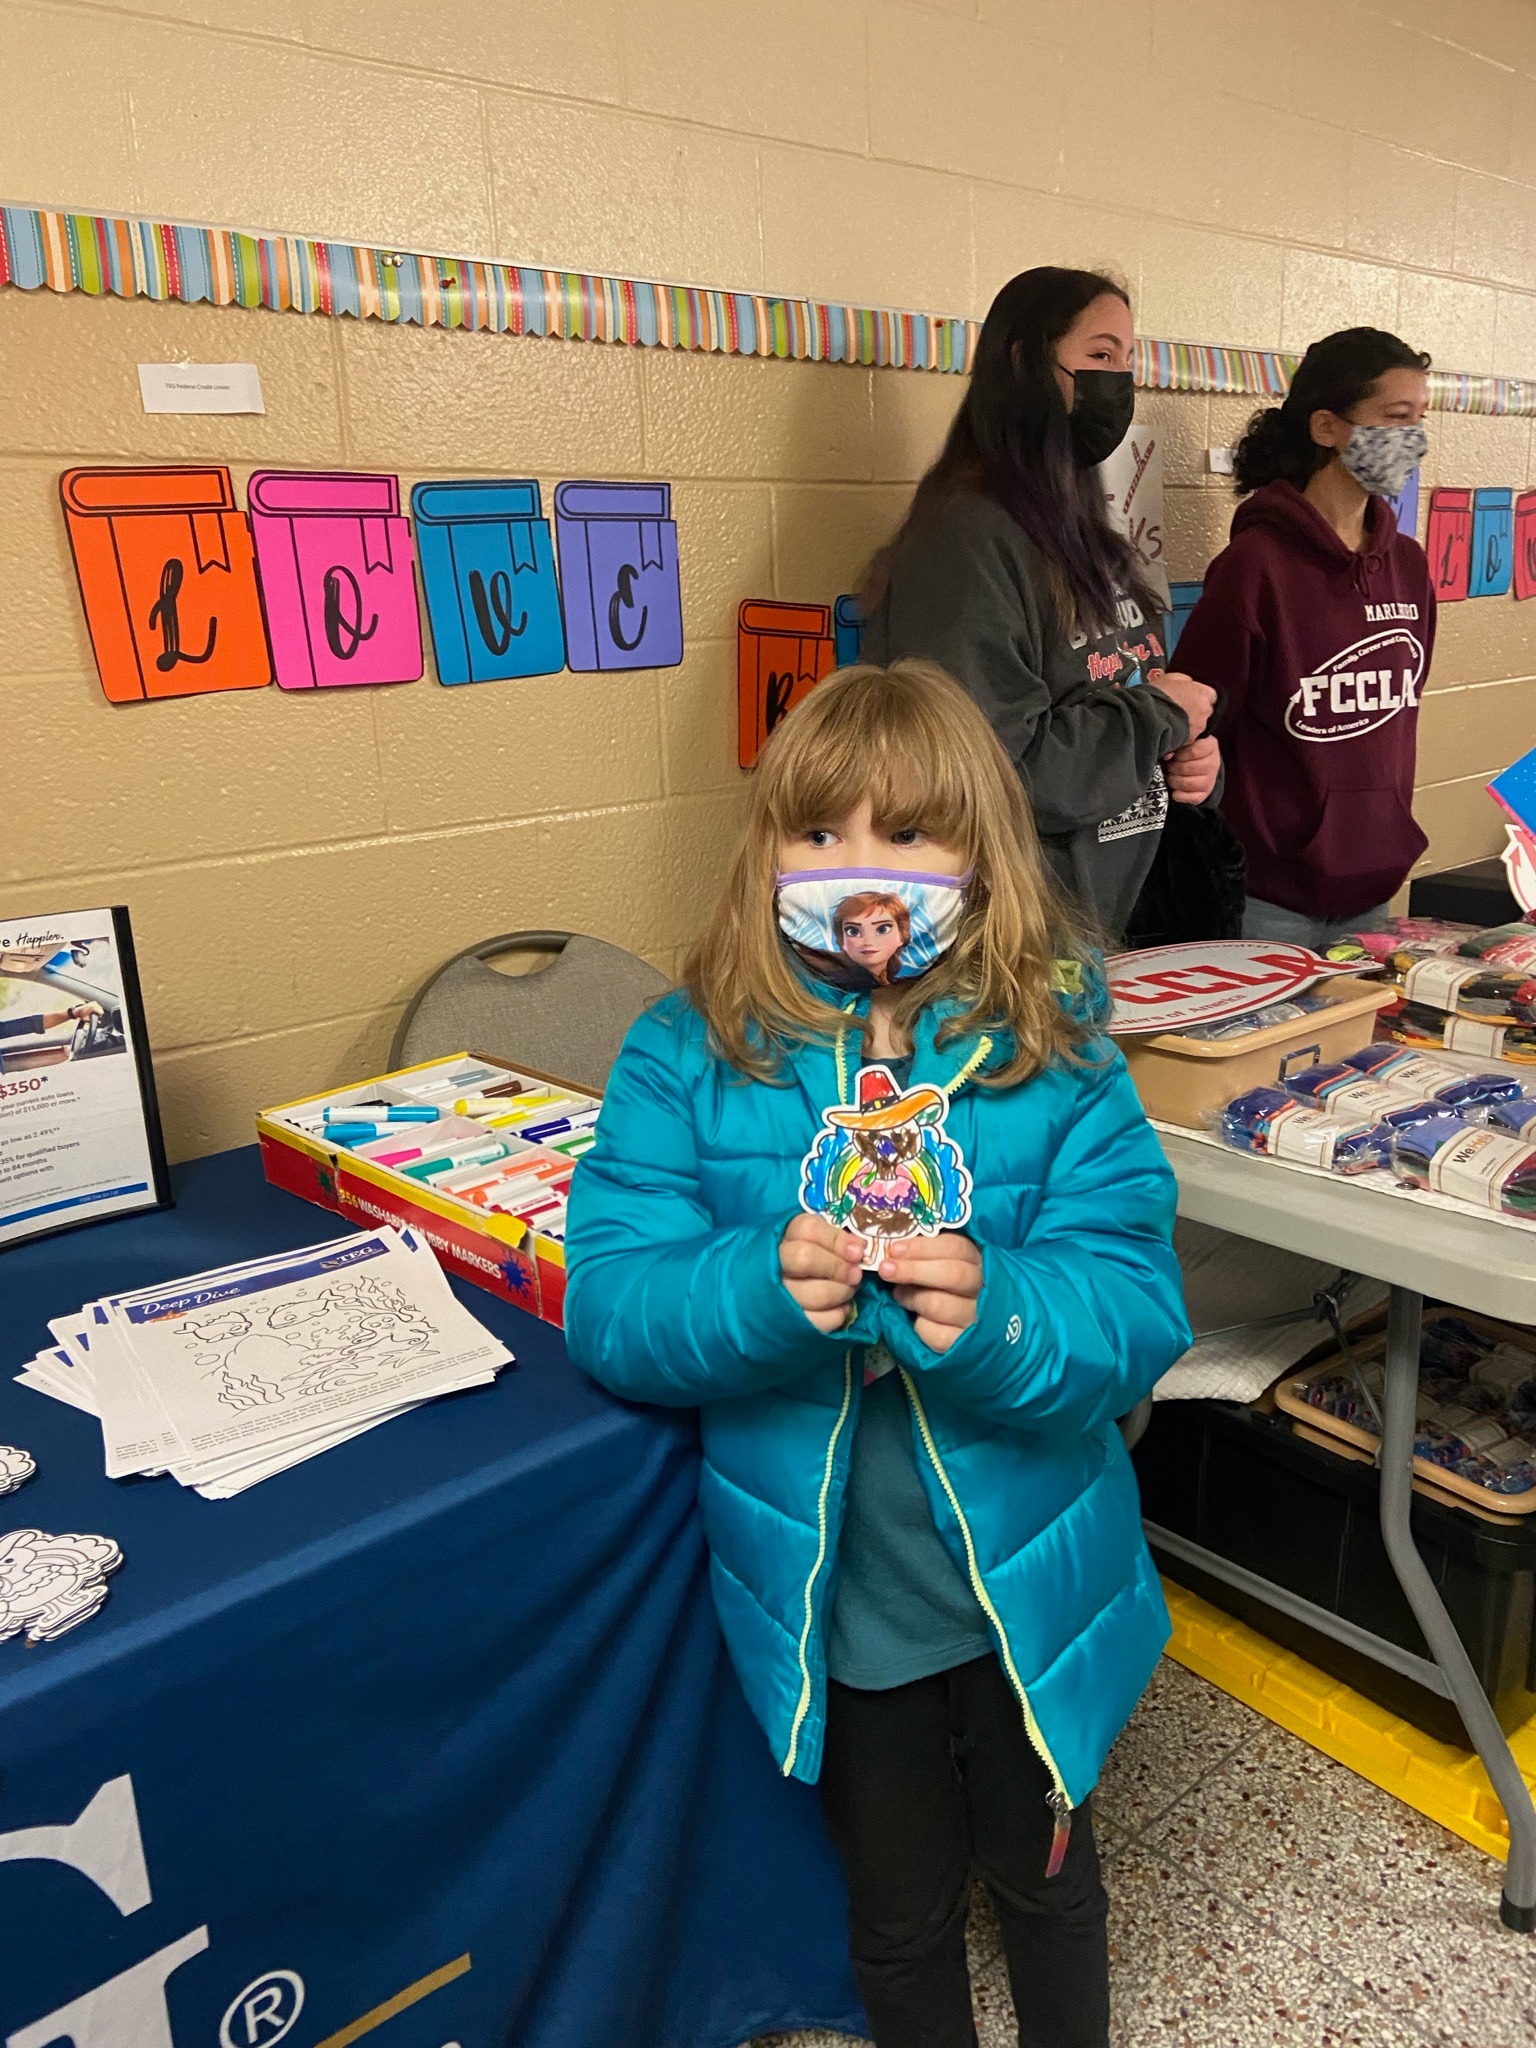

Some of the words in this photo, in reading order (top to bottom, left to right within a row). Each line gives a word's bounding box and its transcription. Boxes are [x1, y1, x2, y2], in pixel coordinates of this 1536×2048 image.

[1299, 668, 1419, 717] FCCLA
[1295, 719, 1328, 735] Leaders
[1336, 717, 1370, 732] America
[1107, 953, 1362, 1005] CCLA
[1188, 994, 1248, 1013] America
[451, 1243, 502, 1280] MARKERS
[142, 1298, 191, 1315] Deep
[193, 1287, 241, 1304] Dive
